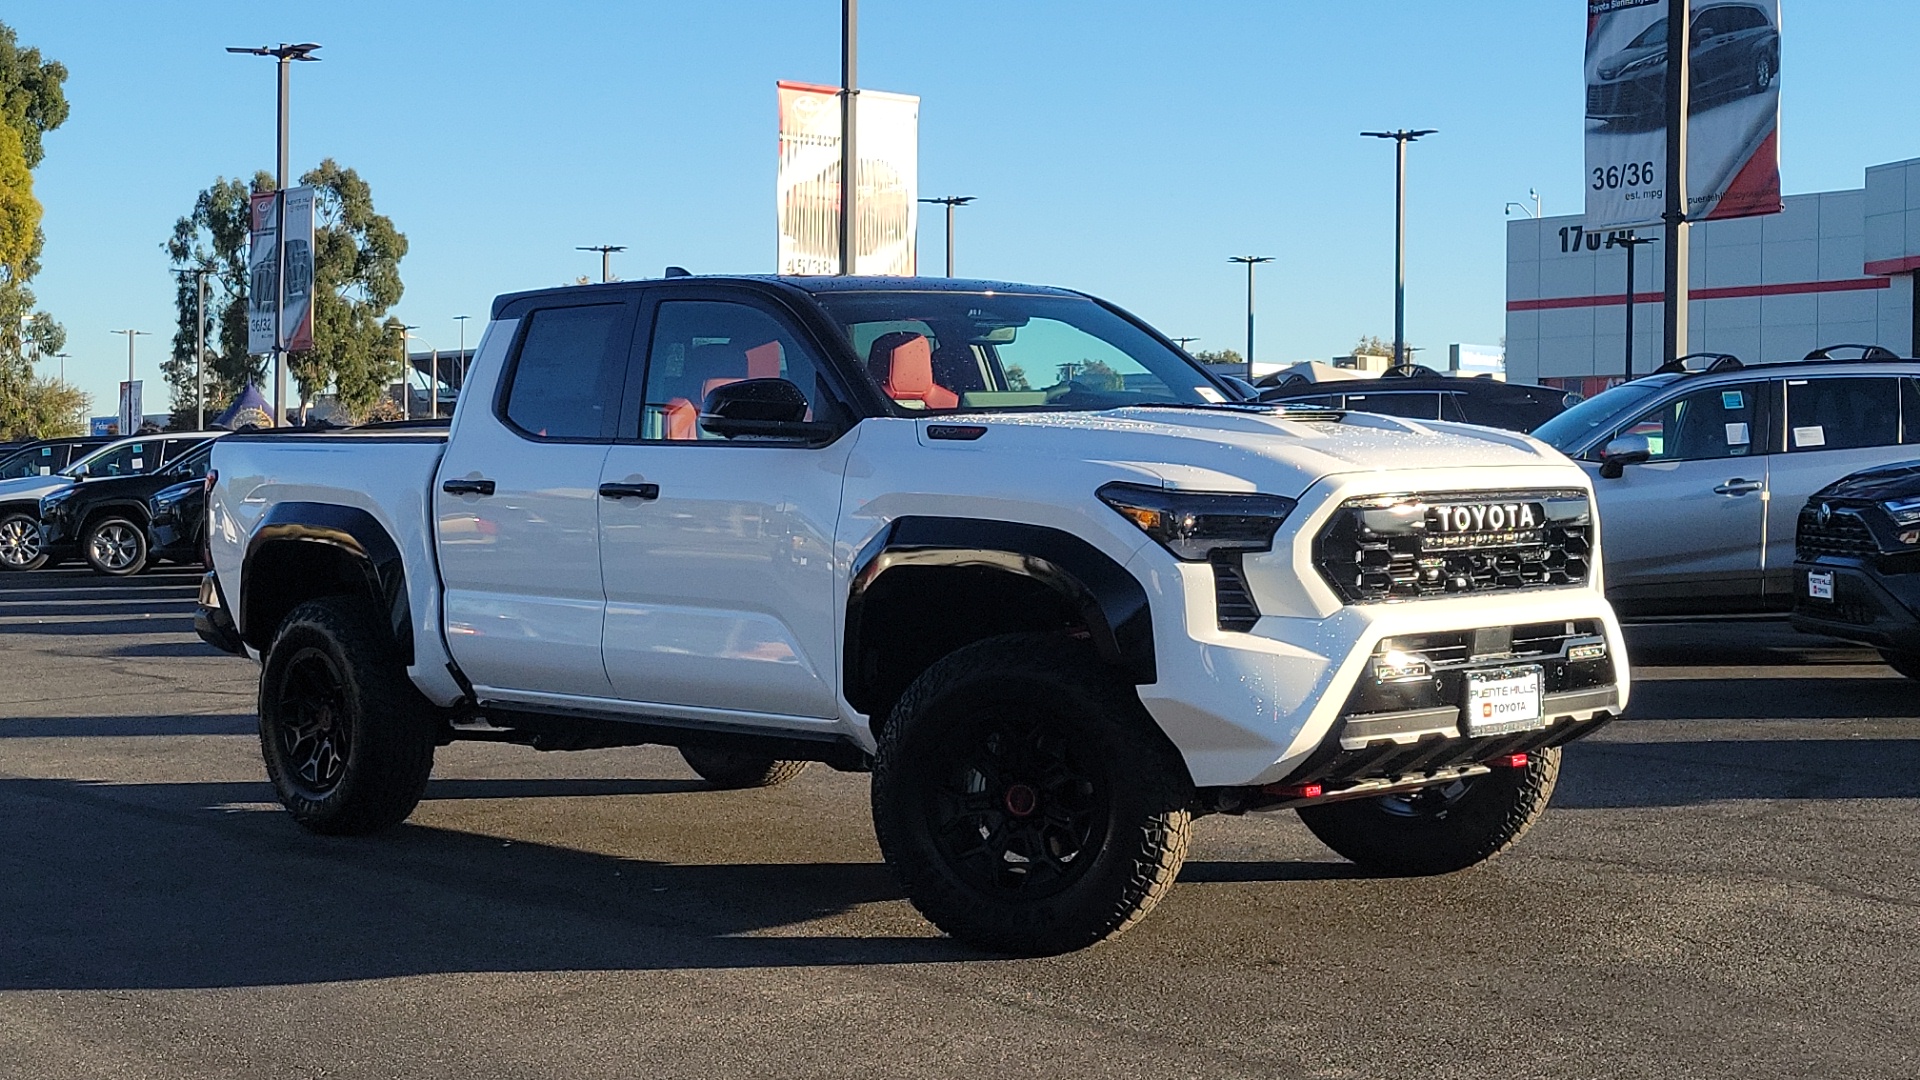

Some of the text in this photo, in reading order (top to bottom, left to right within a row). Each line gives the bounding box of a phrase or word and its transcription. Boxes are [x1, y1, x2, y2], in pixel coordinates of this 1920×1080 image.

[1592, 161, 1654, 191] 36/36
[1643, 189, 1663, 199] mpg
[251, 317, 271, 332] 36/32
[1438, 504, 1535, 532] TOYOTA
[1470, 683, 1537, 699] PUENTE HILLS
[1494, 702, 1526, 714] TOYOTA
